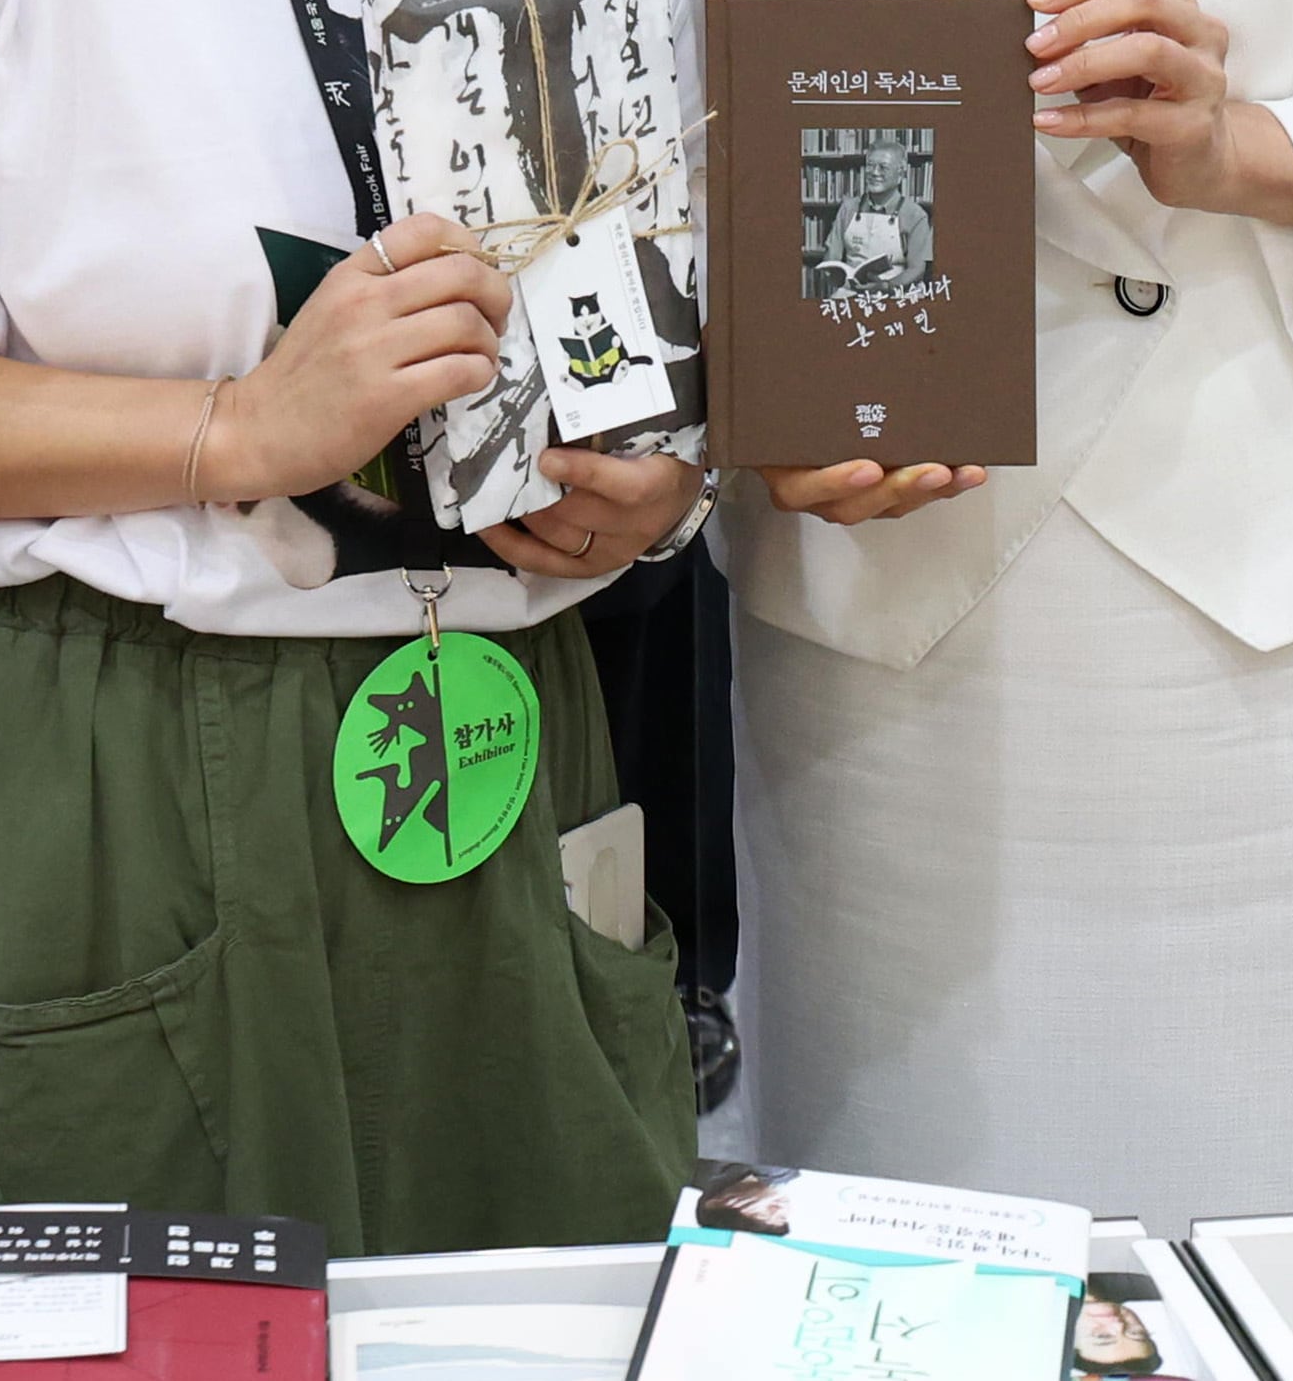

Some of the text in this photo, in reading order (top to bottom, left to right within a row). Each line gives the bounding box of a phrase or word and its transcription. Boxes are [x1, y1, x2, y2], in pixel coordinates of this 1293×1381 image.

[787, 70, 962, 96] 문재인의 독서노트
[356, 144, 369, 172] Fair
[366, 174, 385, 213] Book
[820, 274, 952, 324] 책의 힘을 믿습니다
[454, 712, 516, 751] 참가사
[459, 742, 516, 769] Exhibitor
